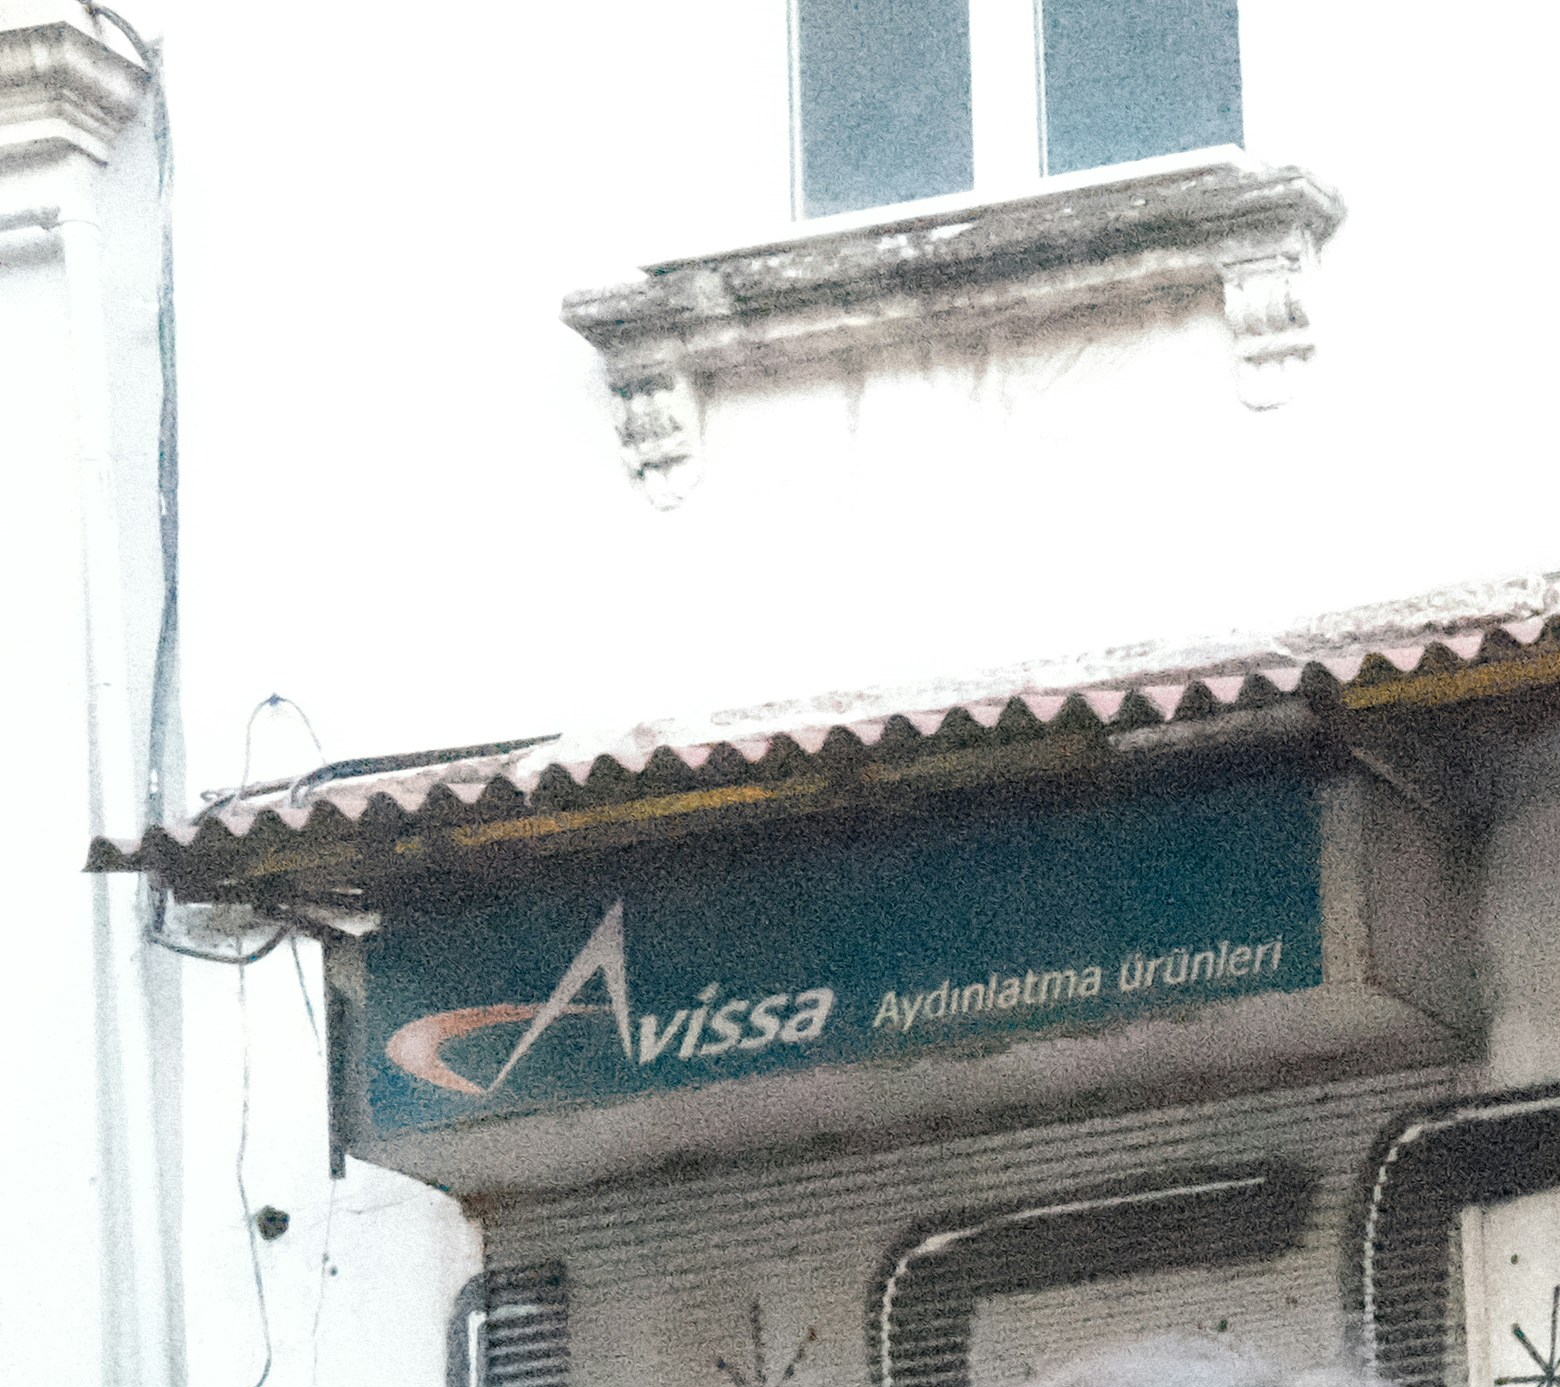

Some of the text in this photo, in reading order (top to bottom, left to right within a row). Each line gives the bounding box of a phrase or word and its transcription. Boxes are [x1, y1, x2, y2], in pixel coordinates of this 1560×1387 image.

[386, 900, 1284, 1095] Avissa Aydınlatma ürünleri
